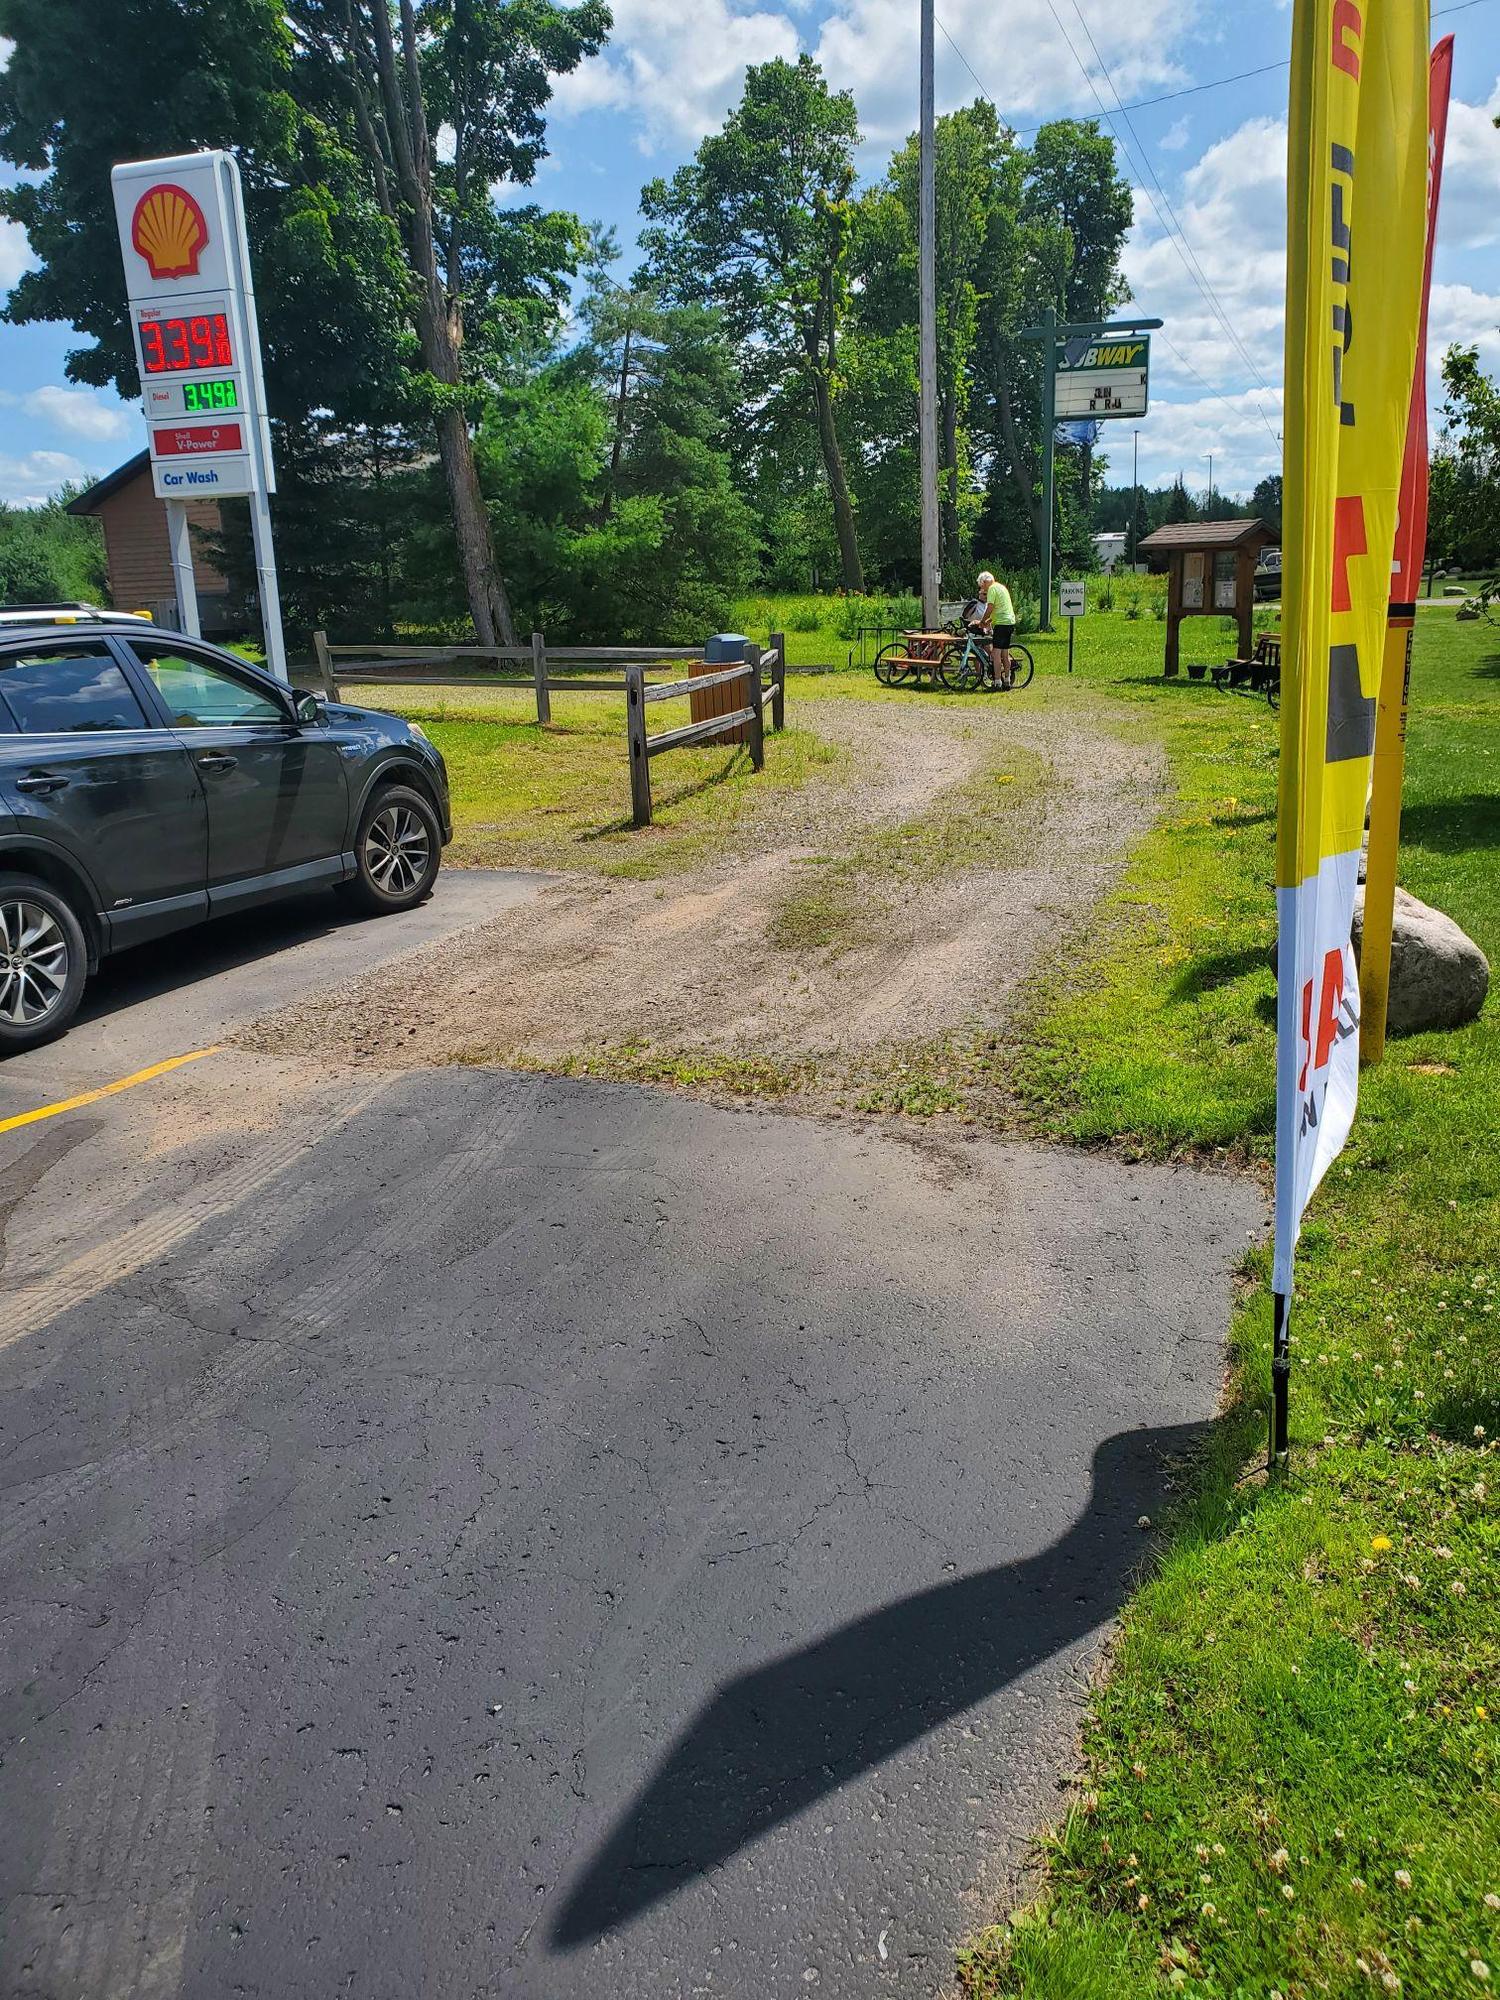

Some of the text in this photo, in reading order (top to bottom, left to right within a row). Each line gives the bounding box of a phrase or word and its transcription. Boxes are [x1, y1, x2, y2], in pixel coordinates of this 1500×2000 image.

[152, 392, 169, 401] Diesel
[175, 431, 191, 440] Shell
[176, 440, 217, 450] V-Power
[163, 470, 219, 486] Car Wash
